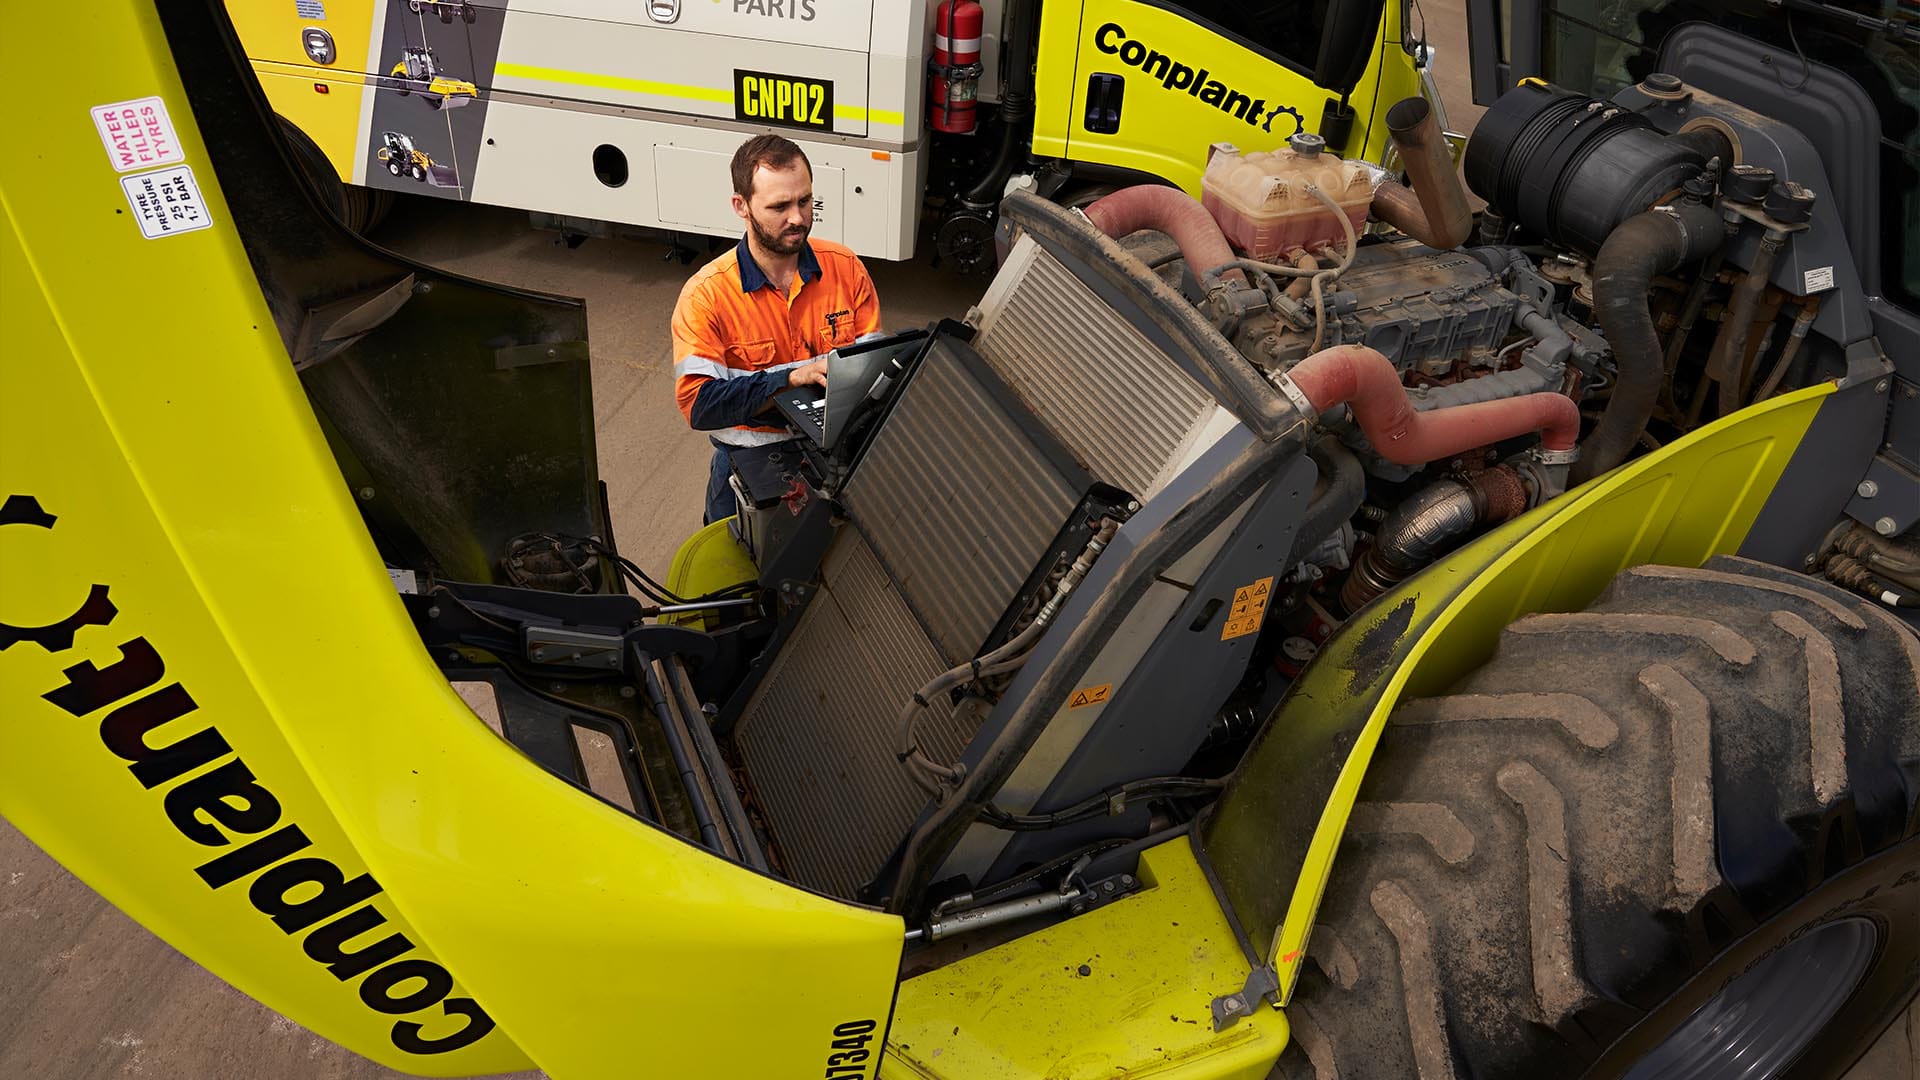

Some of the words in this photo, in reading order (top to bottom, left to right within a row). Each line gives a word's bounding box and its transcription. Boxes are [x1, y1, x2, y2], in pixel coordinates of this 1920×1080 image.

[1095, 23, 1265, 126] Conplant
[103, 111, 135, 166] WATER
[122, 108, 153, 162] FILLED
[140, 106, 170, 158] TYRES
[136, 193, 153, 221] TYRE
[142, 178, 171, 231] PRESSURE
[160, 182, 177, 203] PSI
[173, 175, 191, 201] BAR
[170, 205, 184, 220] 25
[184, 205, 199, 221] 1.7
[825, 309, 850, 319] Conplan
[40, 635, 497, 1055] Conplant
